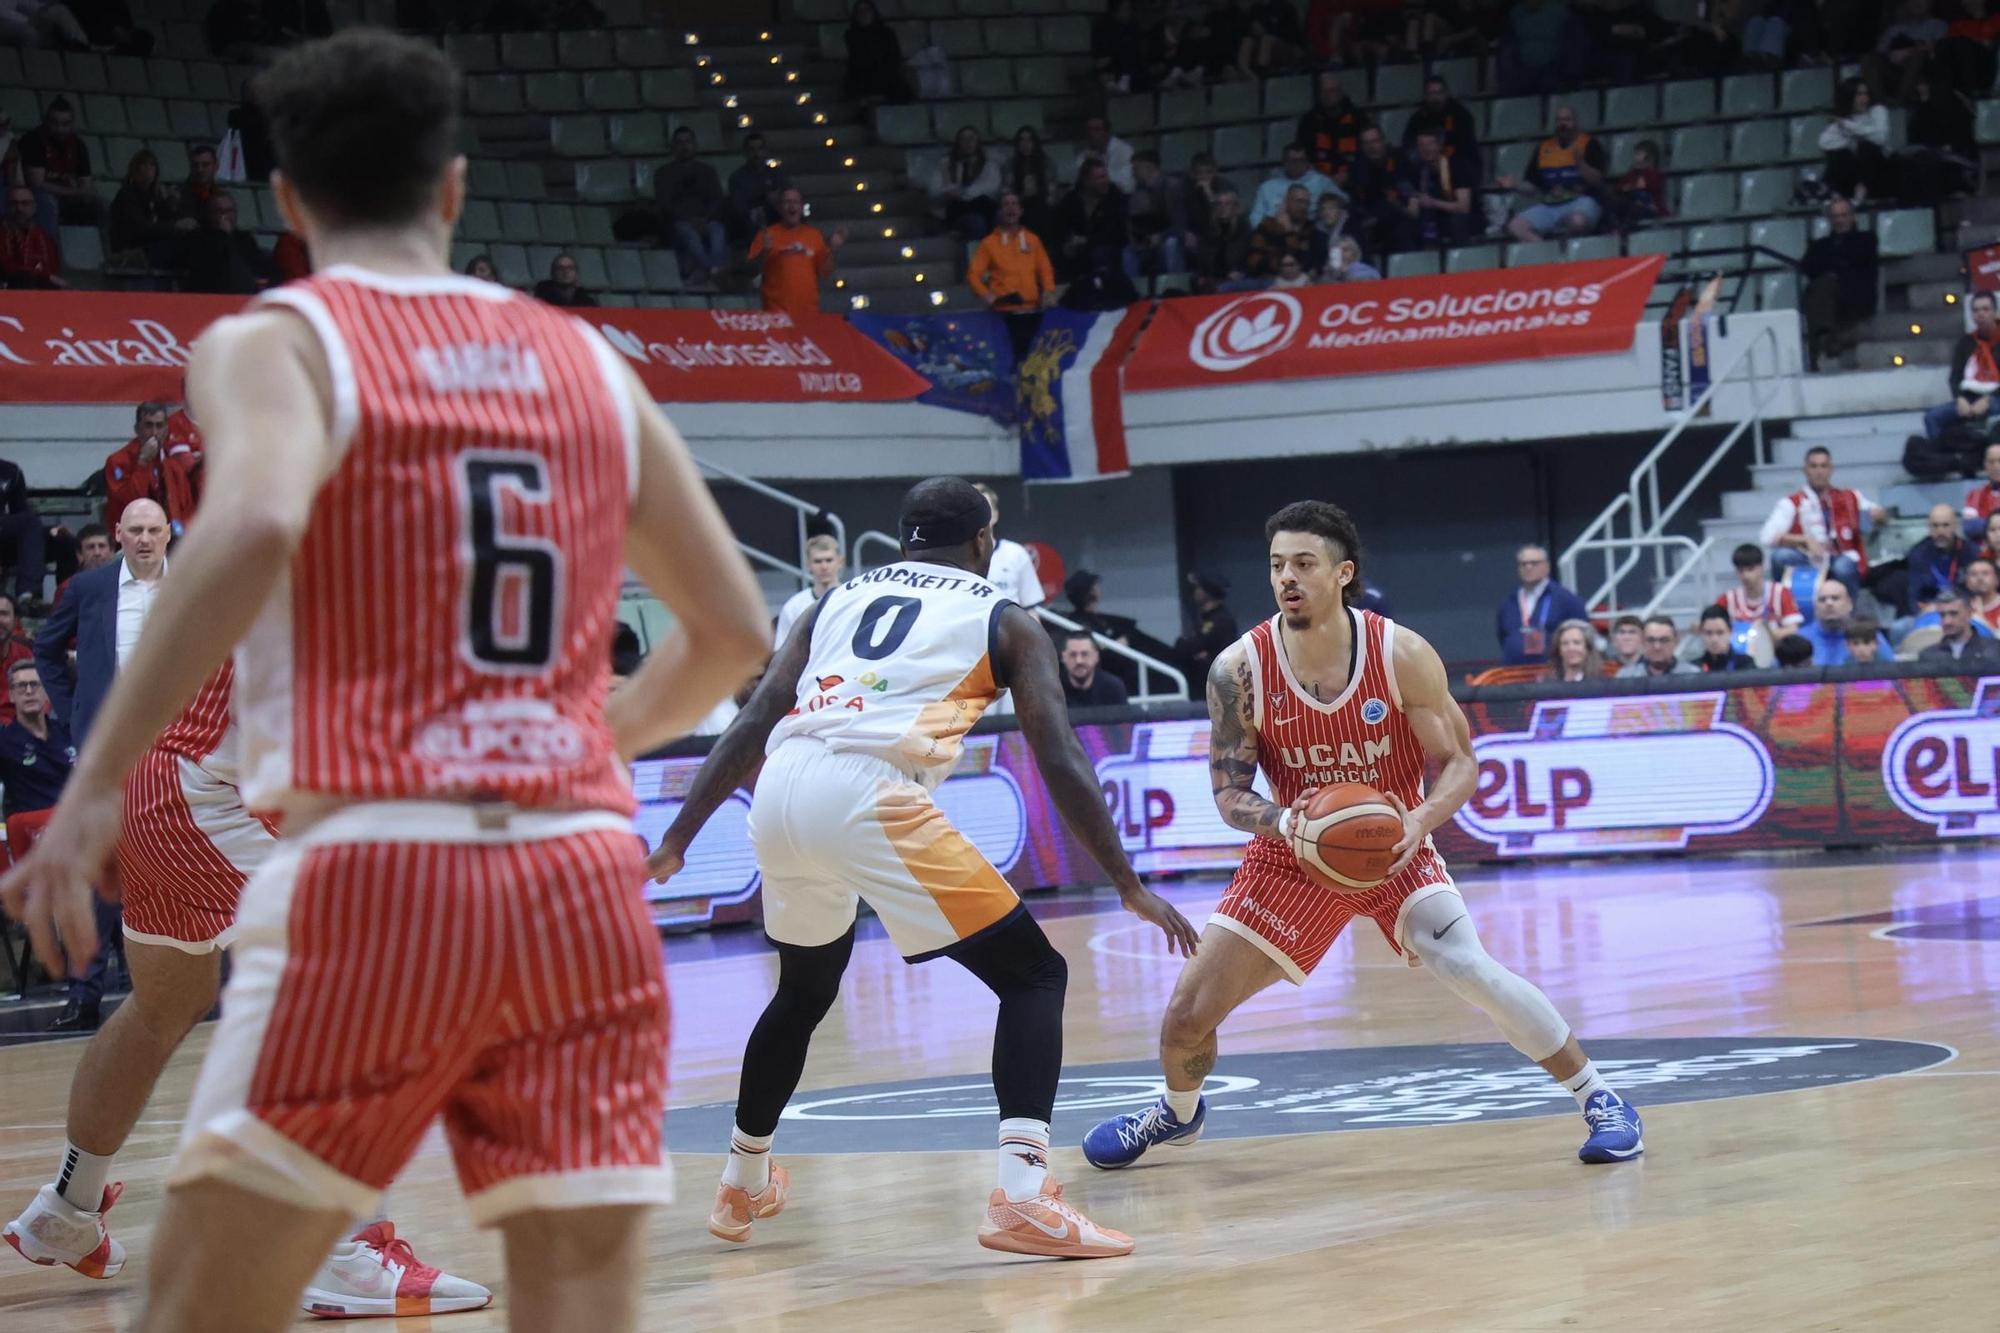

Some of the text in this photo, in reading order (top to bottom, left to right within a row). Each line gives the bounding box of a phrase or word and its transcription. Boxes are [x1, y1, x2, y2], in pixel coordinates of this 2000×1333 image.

[1320, 284, 1602, 328] OC Soluciones
[1306, 310, 1592, 349] Medioambientales
[460, 450, 560, 674] 6
[852, 595, 922, 661] 0
[1281, 734, 1392, 769] UCAM
[1304, 768, 1380, 784] MURCIA
[1241, 896, 1301, 942] INVERSUS
